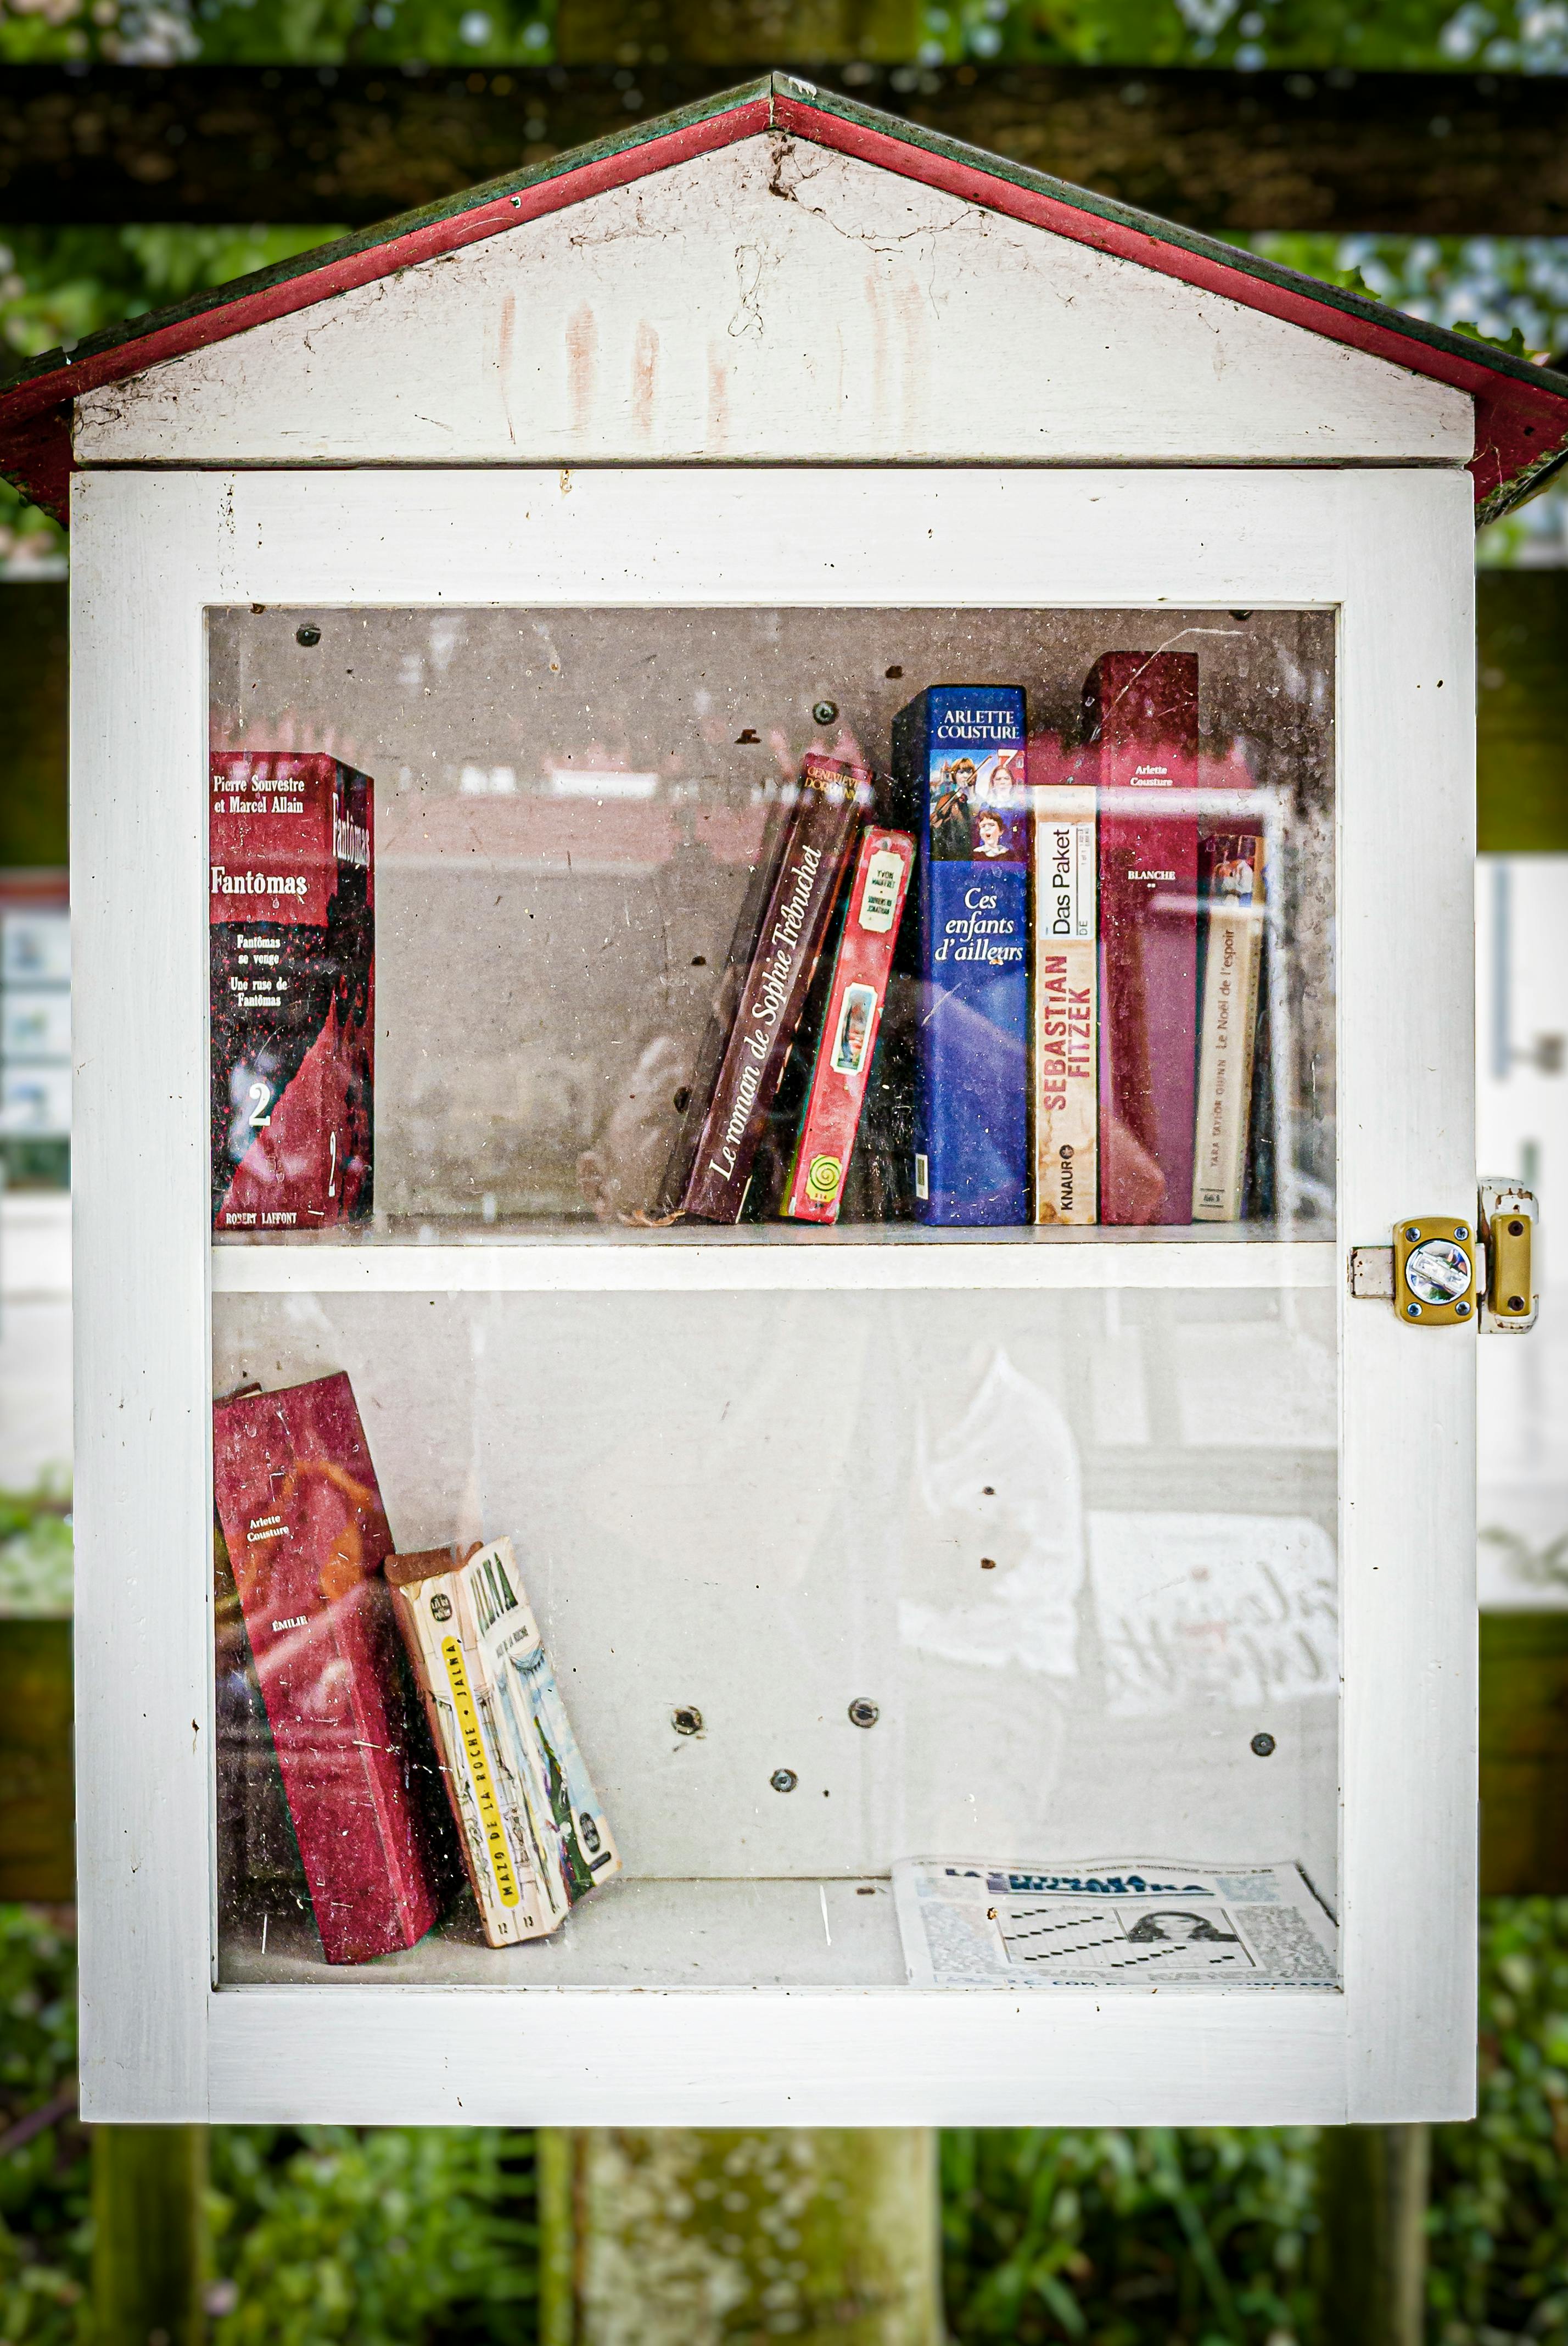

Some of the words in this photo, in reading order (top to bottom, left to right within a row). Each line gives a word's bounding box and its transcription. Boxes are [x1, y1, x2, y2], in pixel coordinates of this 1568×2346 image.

[944, 710, 1015, 724] ARLETTE
[937, 725, 1020, 739] COUSTURE
[1130, 777, 1173, 786] Cousture
[1135, 765, 1168, 775] Arlette
[213, 776, 248, 792] Pierre
[251, 774, 305, 793] Souvestre
[214, 800, 226, 813] et
[229, 796, 267, 813] Marcel
[271, 796, 304, 814] Allain
[1052, 828, 1071, 889] Paket
[211, 866, 308, 895] Fantômas
[1128, 870, 1176, 880] BLANCHE
[771, 845, 823, 947] Trébuchet
[965, 887, 997, 910] Ces
[1052, 895, 1071, 935] Das
[945, 912, 1015, 943] enfants
[1078, 920, 1089, 935] DE
[237, 935, 281, 949] Fantômas
[238, 954, 249, 965] se
[253, 954, 279, 967] venge
[230, 977, 249, 991] Une
[252, 980, 273, 991] ruse
[276, 977, 288, 991] de
[751, 949, 792, 1024] Sophie
[1219, 979, 1231, 996] de
[237, 992, 281, 1007] Fantômas
[1217, 1000, 1229, 1030] Noël
[744, 1026, 770, 1062] de
[1044, 956, 1067, 1112] SEBASTIAN
[1068, 988, 1091, 1079] FITZEK
[248, 1082, 271, 1127] 2
[725, 1066, 760, 1143] roman
[709, 1144, 738, 1182] Le
[1060, 1160, 1073, 1211] KNAUR
[226, 1212, 257, 1225] ROBERT
[261, 1211, 297, 1225] LAFFONT
[249, 1513, 281, 1530] Arlette
[247, 1525, 290, 1543] Cousture
[445, 1644, 467, 1695] JALNA
[467, 1727, 485, 1781] ROCHE
[479, 1788, 494, 1811] LA
[489, 1820, 503, 1841] DE
[494, 1852, 513, 1897] MAZO
